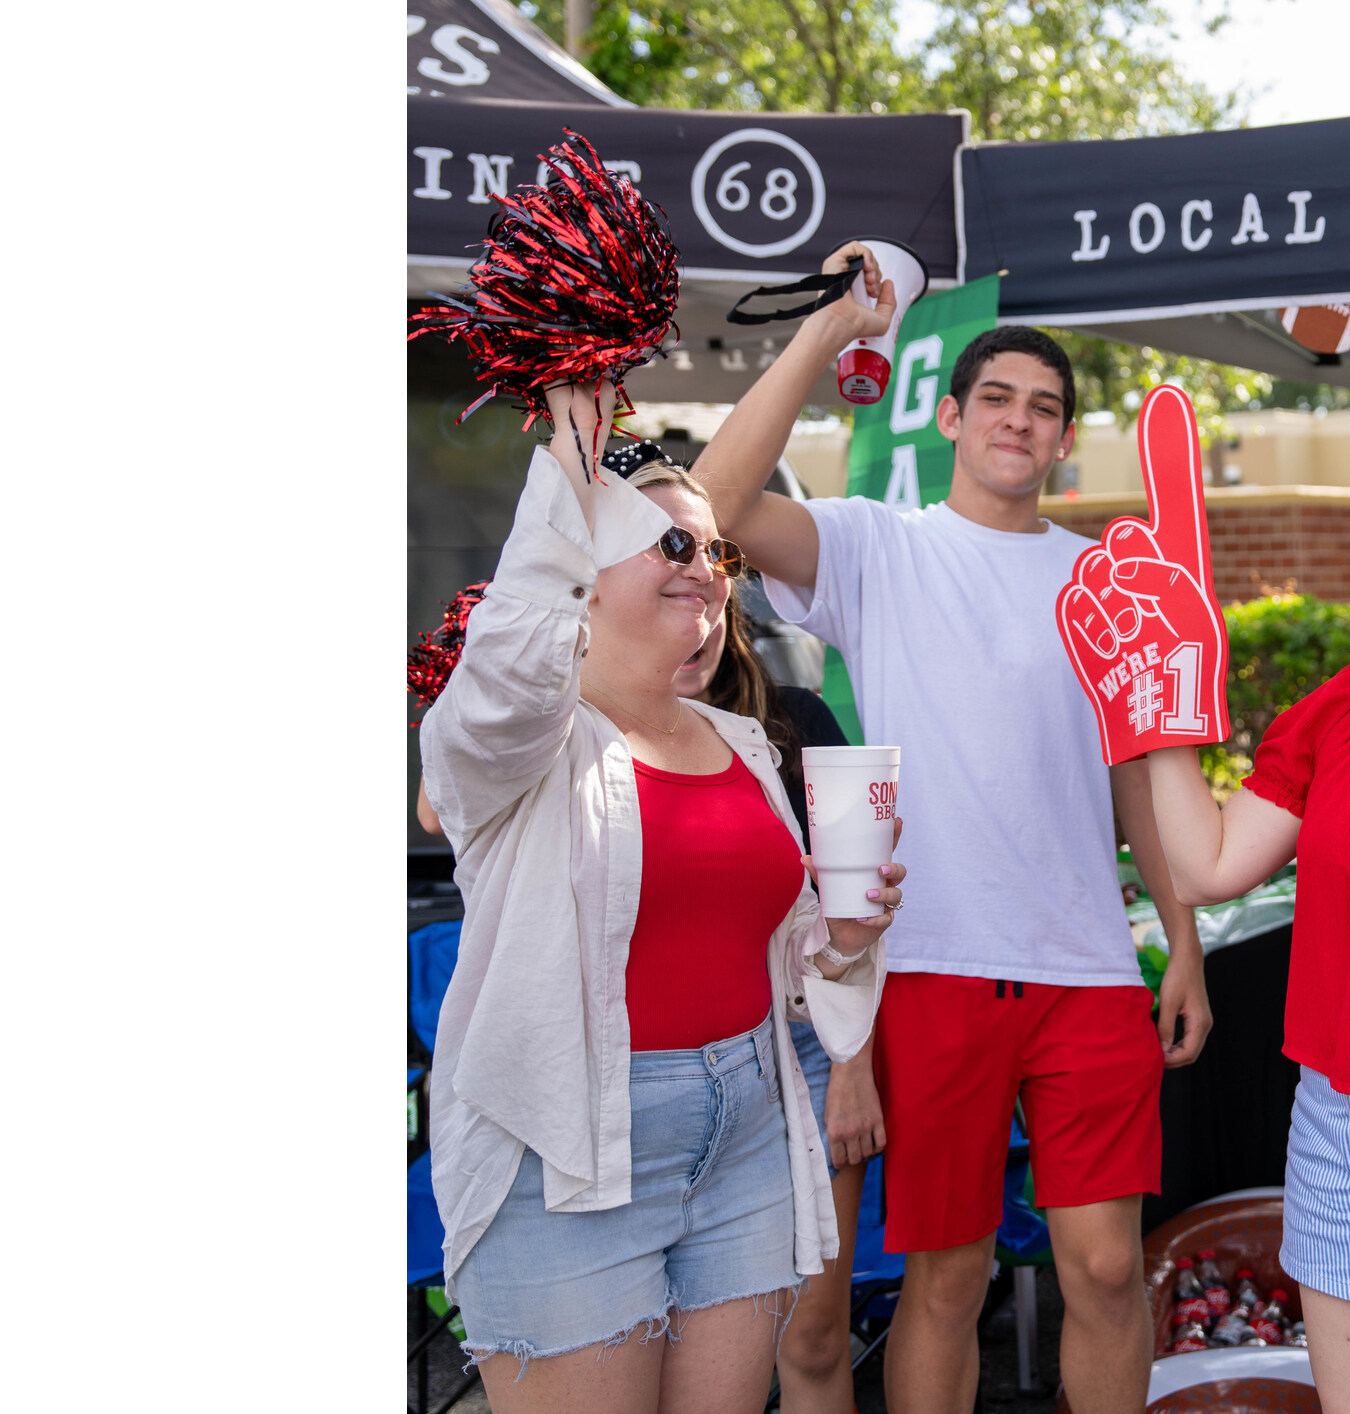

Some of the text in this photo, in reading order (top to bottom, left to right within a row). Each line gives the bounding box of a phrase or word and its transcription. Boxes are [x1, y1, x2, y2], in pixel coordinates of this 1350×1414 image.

[716, 161, 798, 220] 68
[1071, 192, 1326, 262] LOCAL
[1097, 641, 1162, 703] WE'RE
[1127, 641, 1208, 737] #1
